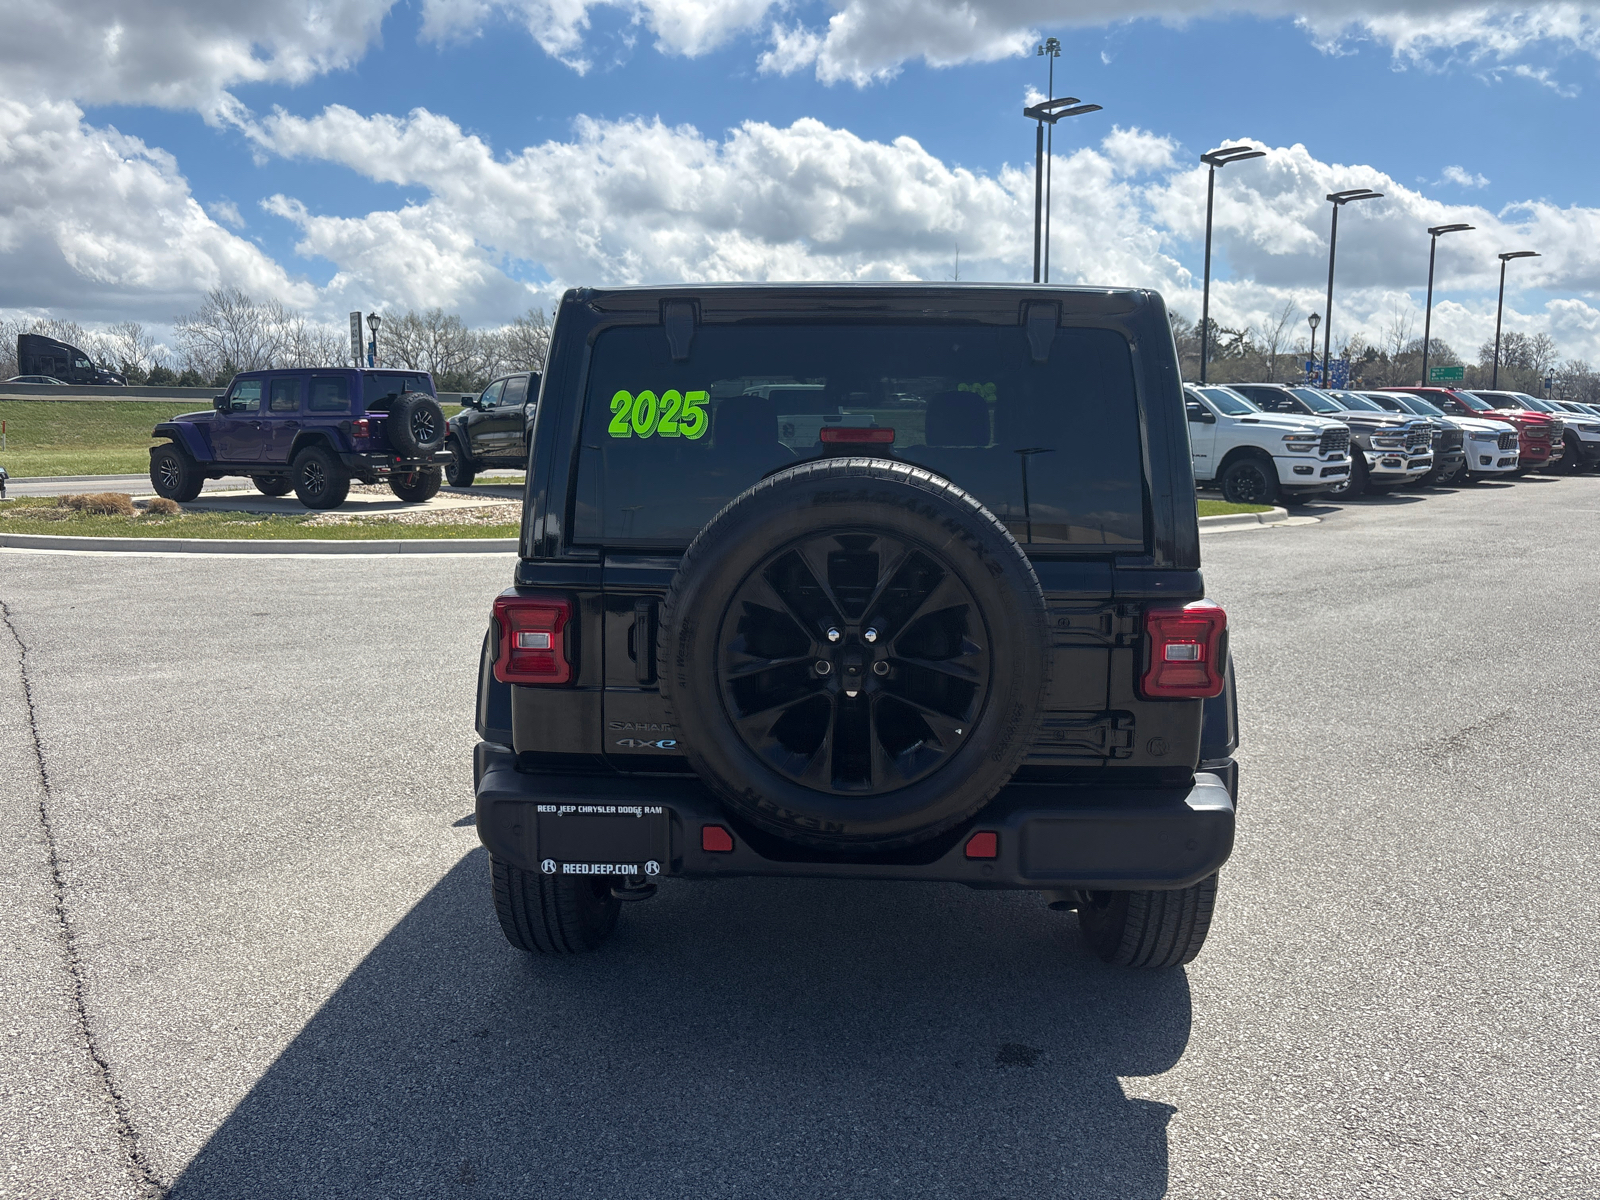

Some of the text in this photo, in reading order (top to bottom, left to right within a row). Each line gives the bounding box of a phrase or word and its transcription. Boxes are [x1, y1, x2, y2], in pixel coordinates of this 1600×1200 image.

[608, 389, 710, 439] 2025
[608, 721, 672, 731] SAHAR
[537, 804, 663, 815] REED JEEP CHRYSLER DODGE RAM
[562, 863, 638, 875] REEDJEEP.COM
